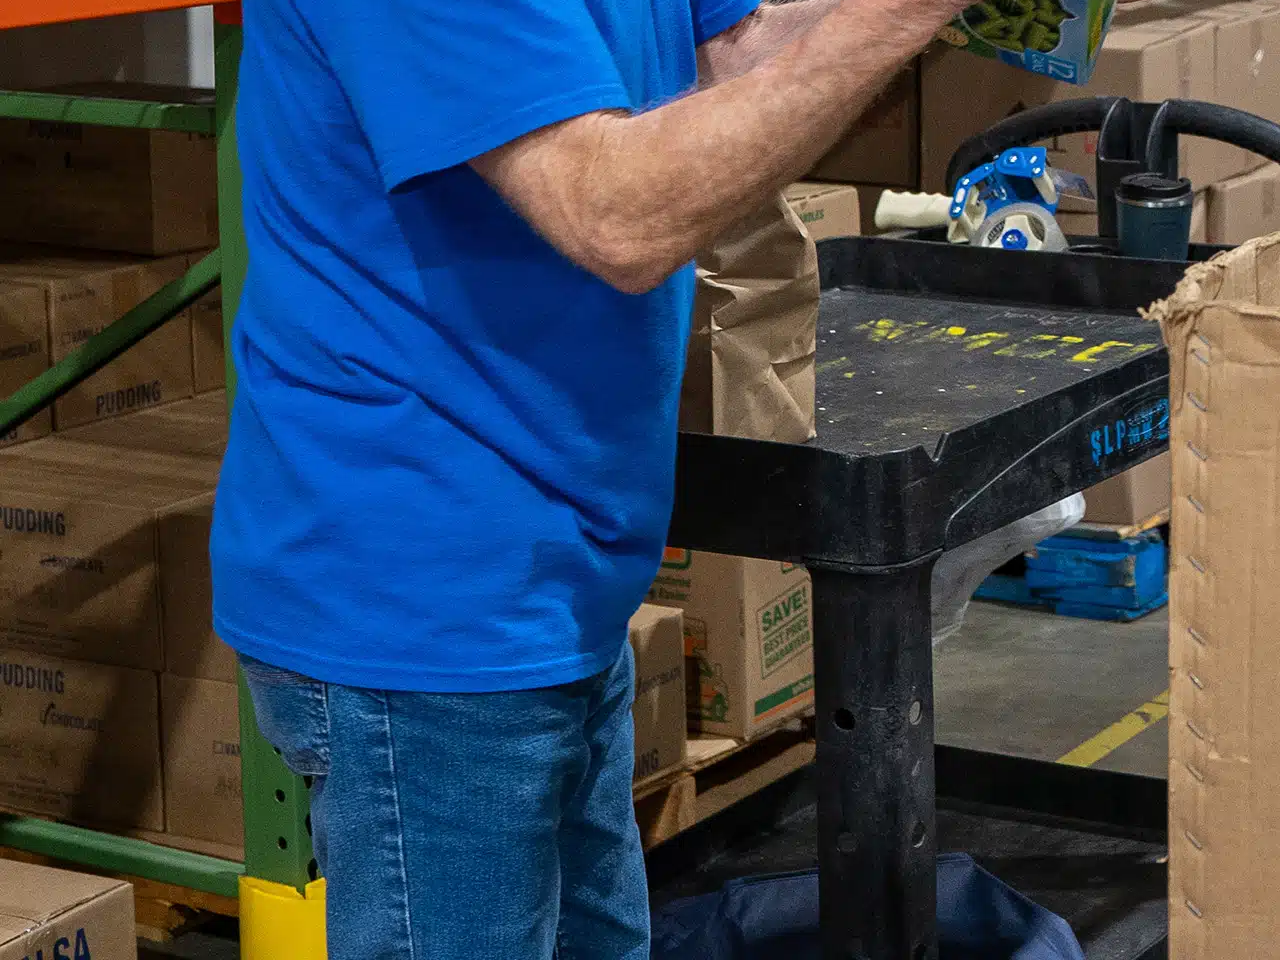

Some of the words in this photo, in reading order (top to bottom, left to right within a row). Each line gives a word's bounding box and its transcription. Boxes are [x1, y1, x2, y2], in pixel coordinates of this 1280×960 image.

[1048, 59, 1075, 79] 12
[96, 379, 162, 415] PUDDING
[762, 586, 809, 632] SAVE!
